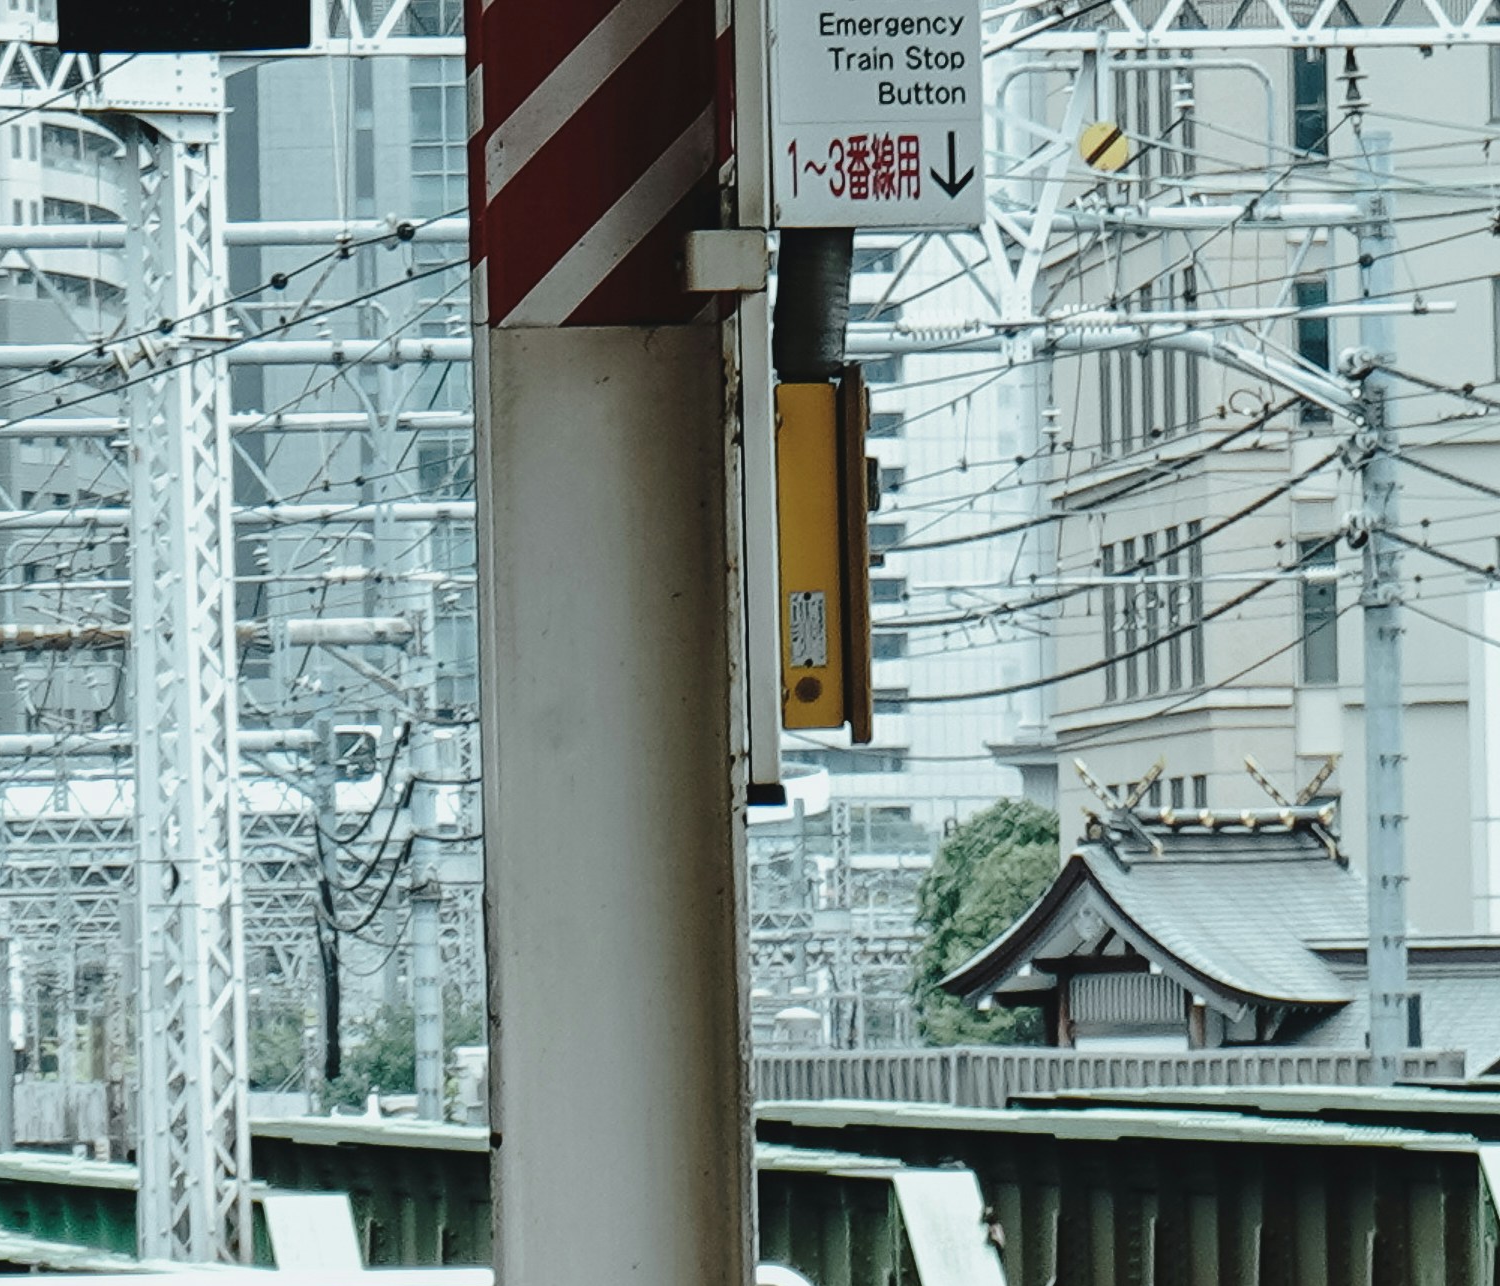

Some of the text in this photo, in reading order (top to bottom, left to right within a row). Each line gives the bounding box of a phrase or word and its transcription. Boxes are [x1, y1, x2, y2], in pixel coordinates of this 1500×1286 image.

[819, 12, 964, 37] Emergency
[828, 45, 965, 72] Train Stop
[878, 81, 967, 106] Button
